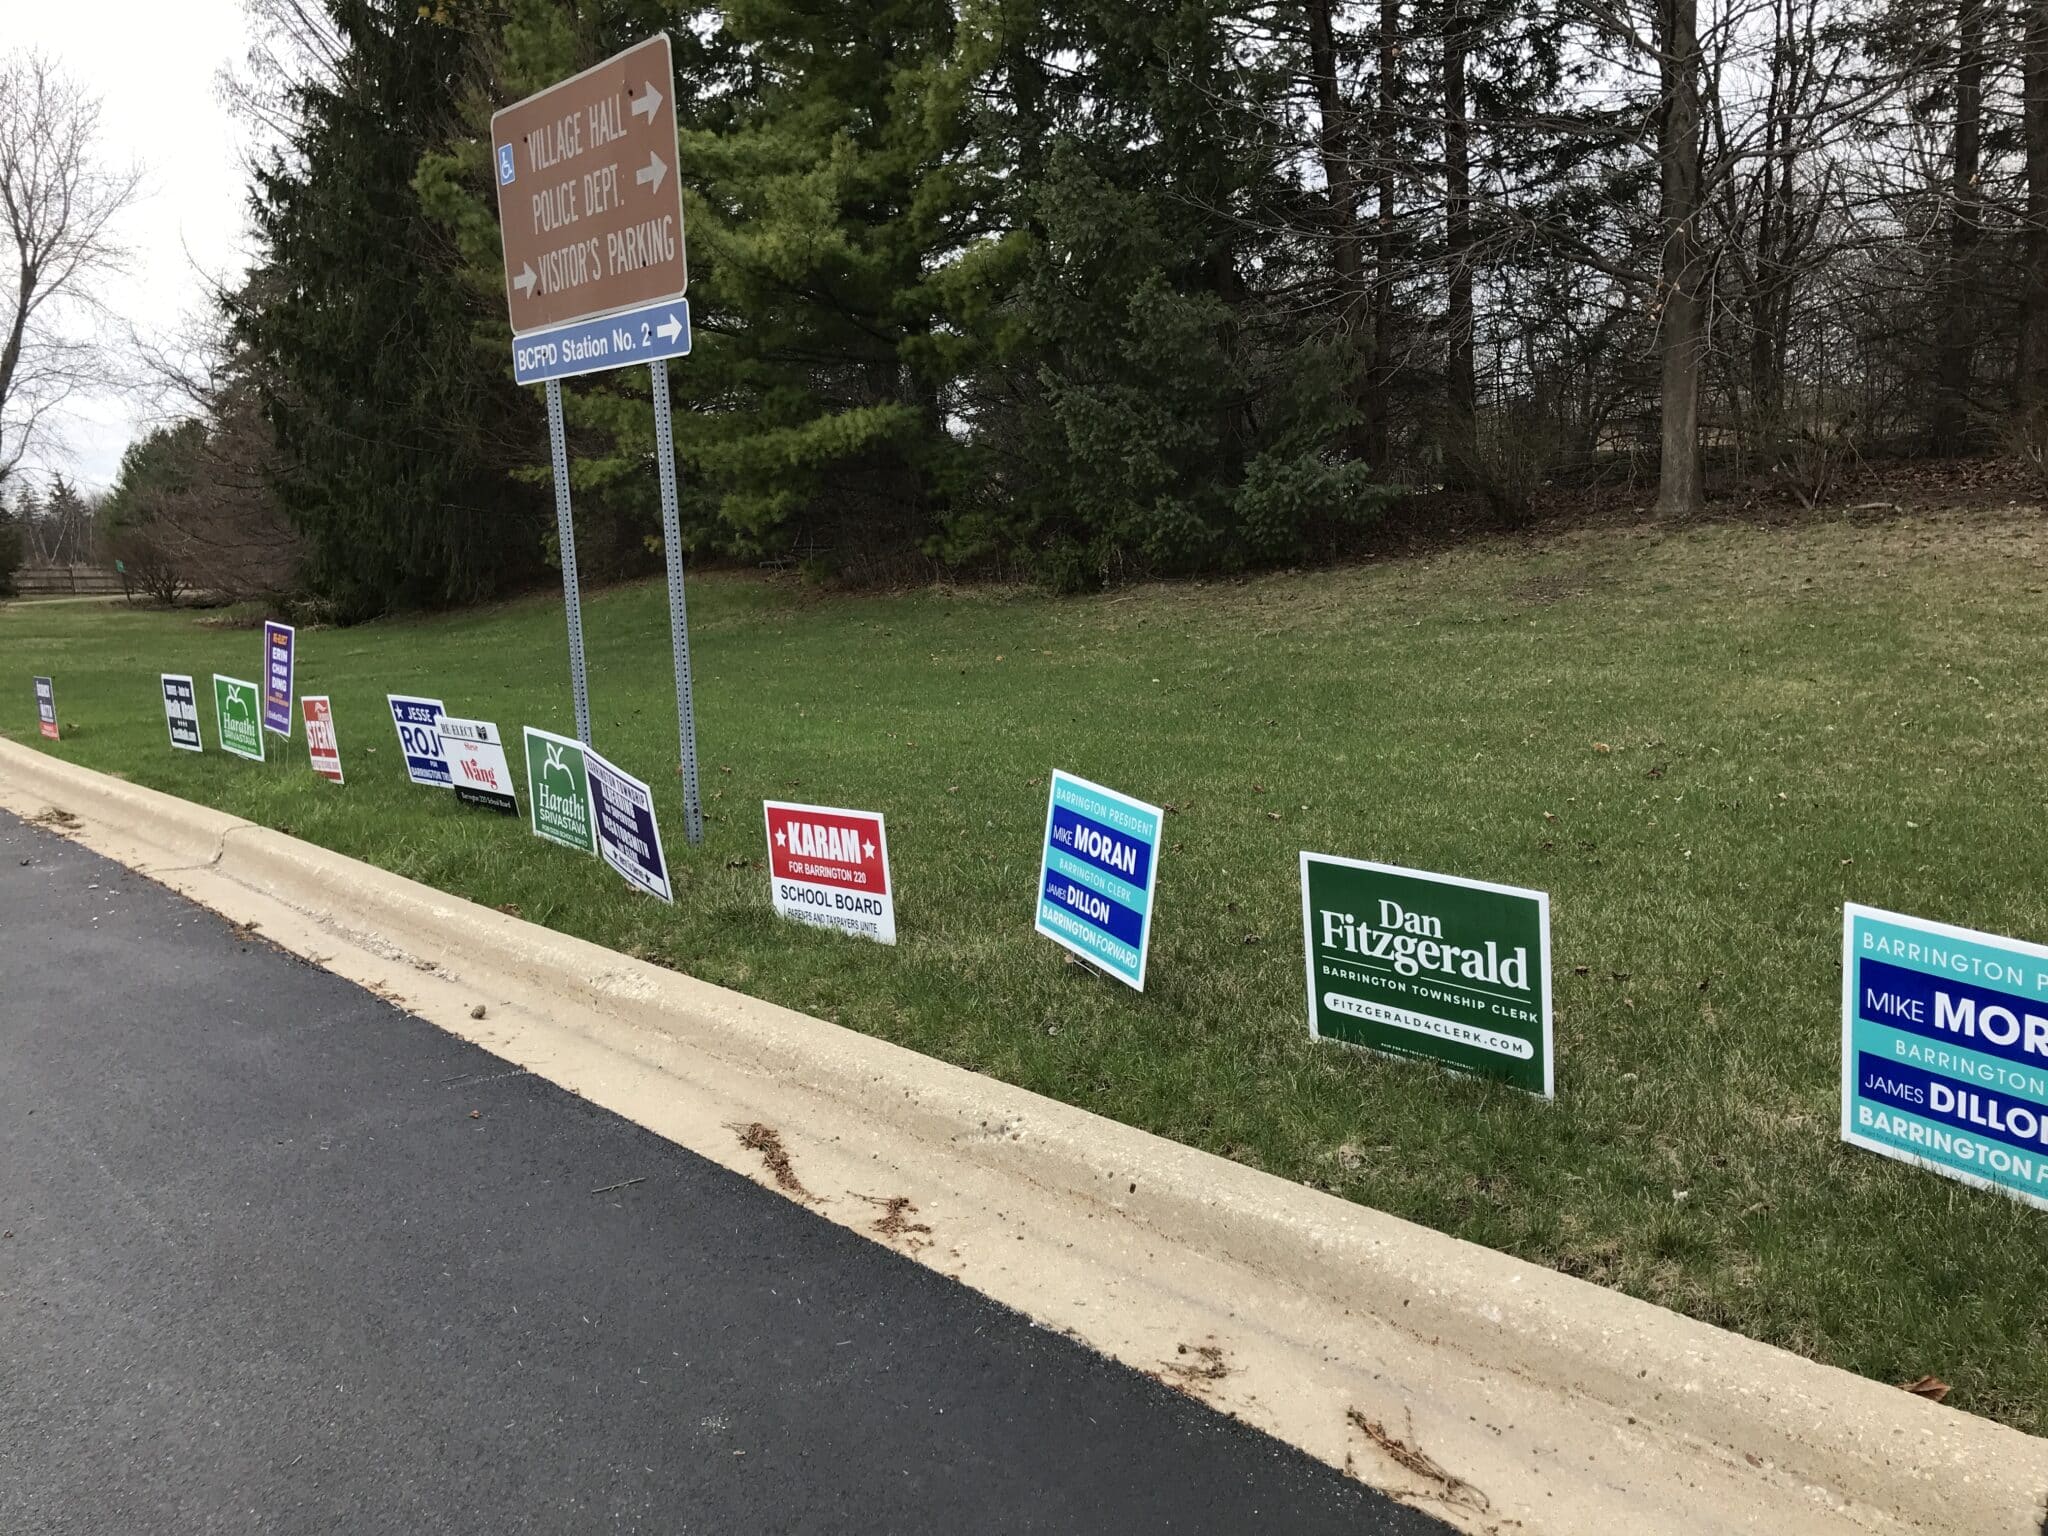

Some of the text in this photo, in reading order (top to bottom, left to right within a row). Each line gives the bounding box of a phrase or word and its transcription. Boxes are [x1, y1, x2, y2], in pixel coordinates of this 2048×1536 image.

[527, 93, 627, 173] VILLAGE HALL
[532, 163, 625, 235] POLICE DEPT.
[537, 214, 675, 295] VISITOR'S PARKING
[518, 322, 652, 371] BCFPD Station No. 2
[408, 706, 433, 722] JESSE
[400, 725, 445, 757] ROJ
[539, 782, 585, 822] Harathi
[616, 775, 645, 806] TOWNSHIP
[1056, 787, 1153, 836] BARRINGTON PRESIDENT
[540, 808, 588, 837] SRIVASTAVA
[787, 821, 862, 864] KARAM
[1053, 823, 1137, 875] MIKE MORAN
[788, 860, 867, 884] FOR BARRINGTON 220
[1059, 857, 1132, 902] BARRINGTON CLERK
[781, 884, 882, 916] SCHOOL BOARD
[787, 907, 813, 921] PARENTS
[813, 912, 825, 923] AND
[826, 914, 859, 930] TAXPAYERS
[1046, 882, 1110, 925] JAMES DILLON
[1378, 898, 1443, 939] Dan
[1320, 909, 1531, 991] Fitzgerald
[1863, 931, 2023, 987] BARRINGTON
[1322, 965, 1538, 1024] BARRINGTON TOWNSHIP CLERK
[1866, 987, 1925, 1023] MIKE
[1333, 998, 1523, 1054] FITZGERALD4CLERK.COM
[1864, 1073, 1924, 1104] JAMES
[1895, 1039, 2044, 1096] BARRINGTON
